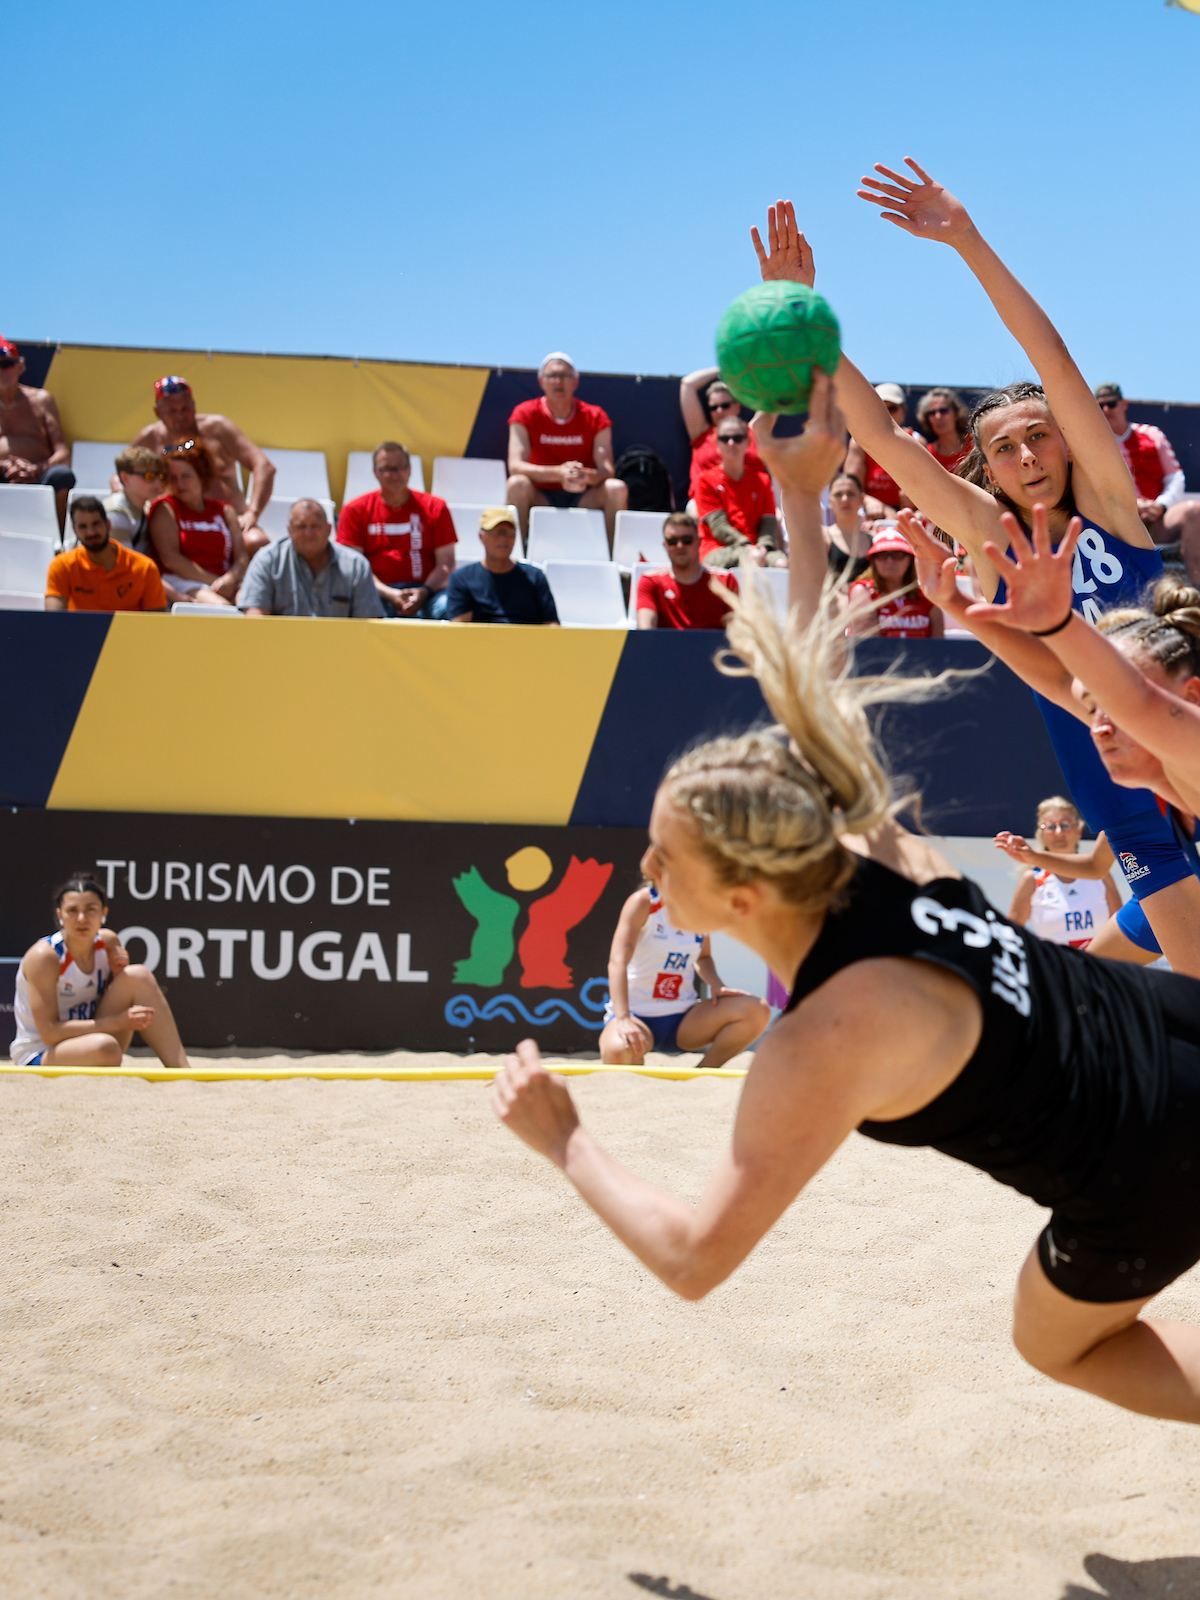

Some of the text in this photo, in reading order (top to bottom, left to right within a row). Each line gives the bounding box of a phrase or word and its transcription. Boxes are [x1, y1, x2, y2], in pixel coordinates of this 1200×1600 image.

[96, 860, 391, 906] TURISMO DE
[1065, 910, 1094, 931] FRA
[115, 926, 430, 983] ORTUGAL
[664, 952, 690, 970] FRA
